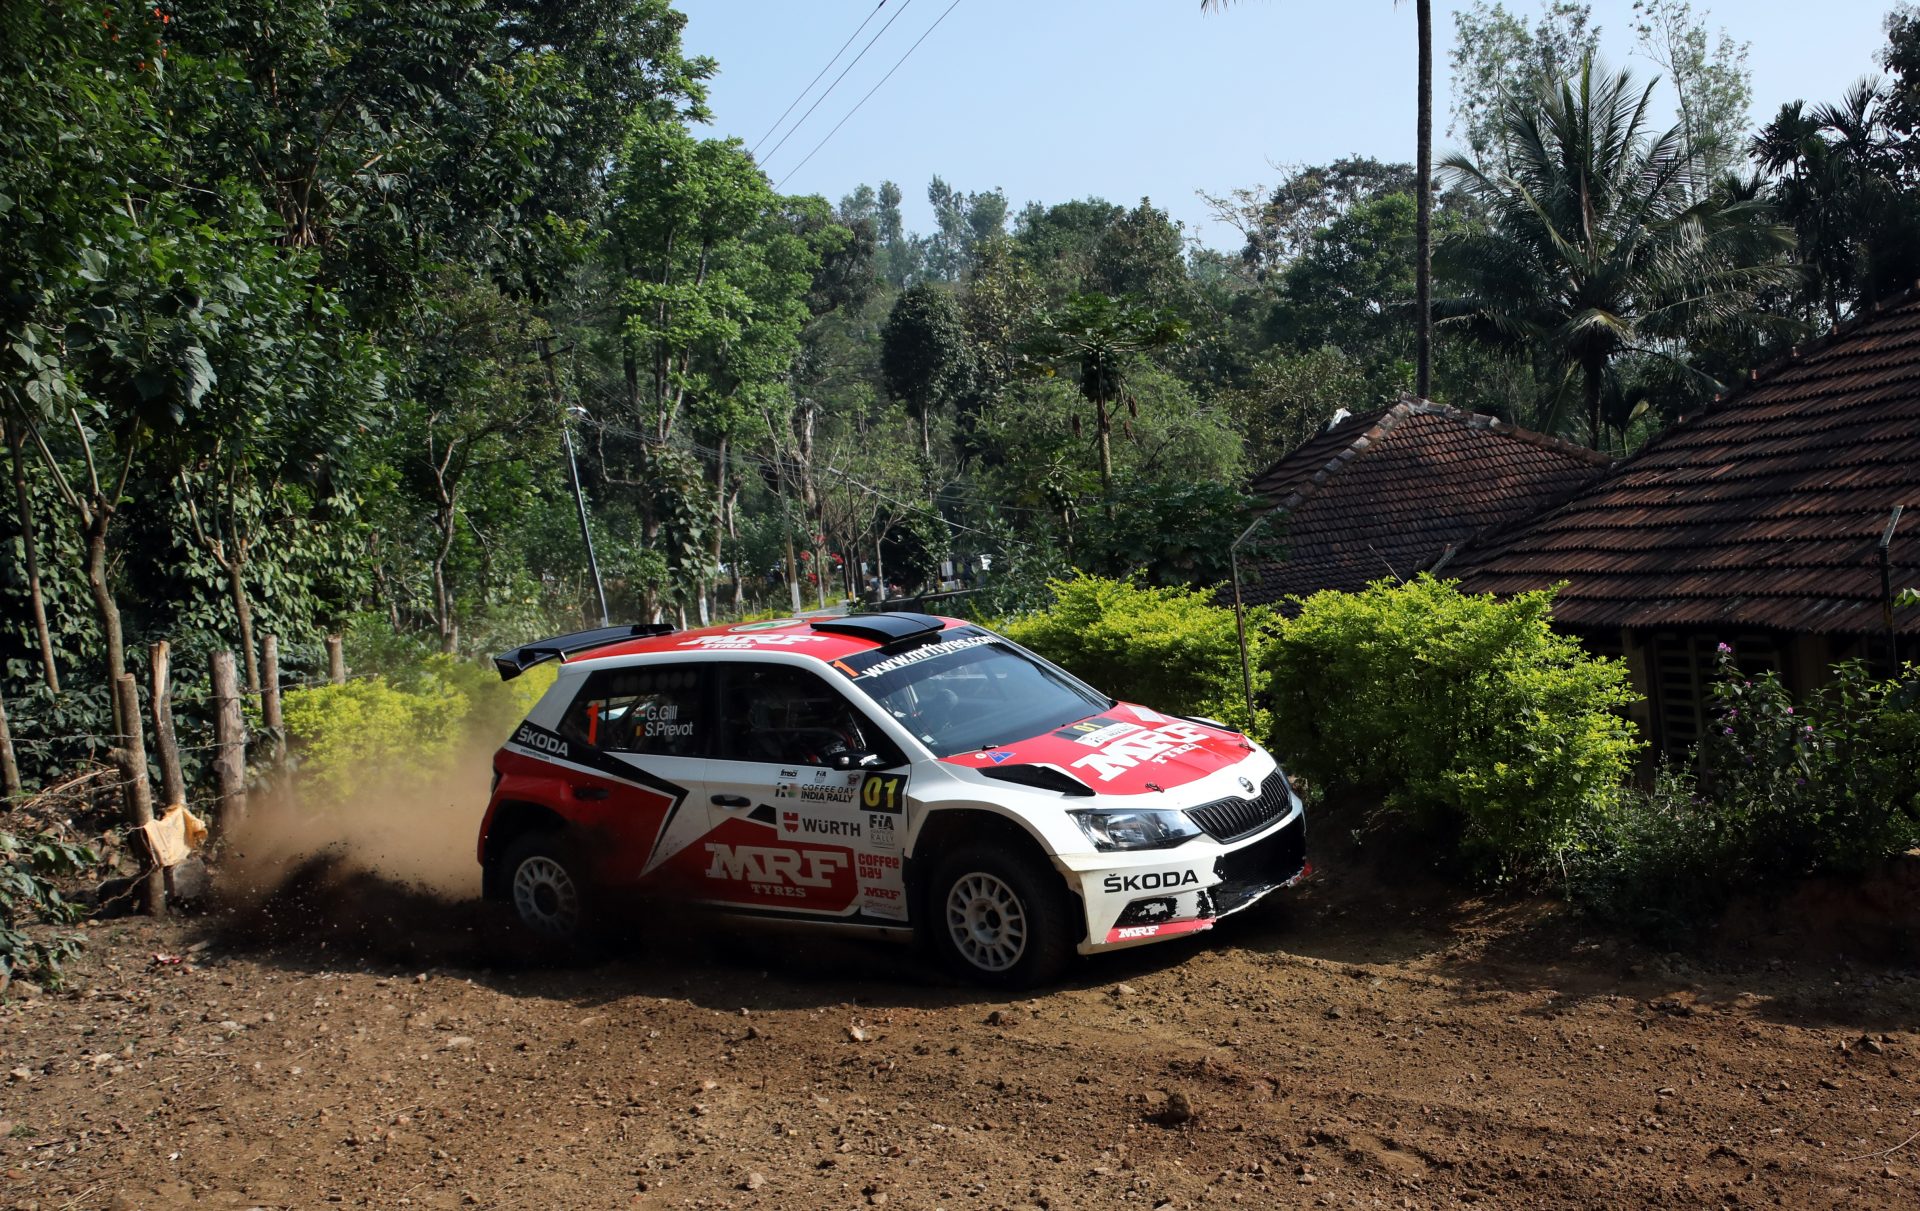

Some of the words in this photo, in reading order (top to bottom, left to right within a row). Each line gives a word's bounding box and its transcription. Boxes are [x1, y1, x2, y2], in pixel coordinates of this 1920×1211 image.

[677, 634, 830, 646] MRF
[862, 634, 1001, 679] www.mrftyres.com
[833, 659, 860, 678] 1
[646, 705, 678, 721] G.Gill
[585, 703, 599, 746] 1
[644, 721, 694, 737] S.Prevot
[1073, 721, 1104, 732] 01
[517, 725, 569, 757] ŠKODA
[1070, 722, 1210, 782] MRF
[1151, 743, 1203, 765] TYRES
[800, 792, 825, 801] INDIA
[826, 793, 855, 803] RALLY
[801, 784, 835, 793] COFFEE
[837, 786, 857, 795] DAY
[863, 776, 899, 809] 01
[802, 818, 861, 837] WÜRTH
[704, 842, 849, 889] MRF
[751, 883, 807, 897] TYRES
[1103, 869, 1199, 894] ŠKODA
[863, 886, 901, 900] MRF
[1118, 925, 1160, 939] MRF
